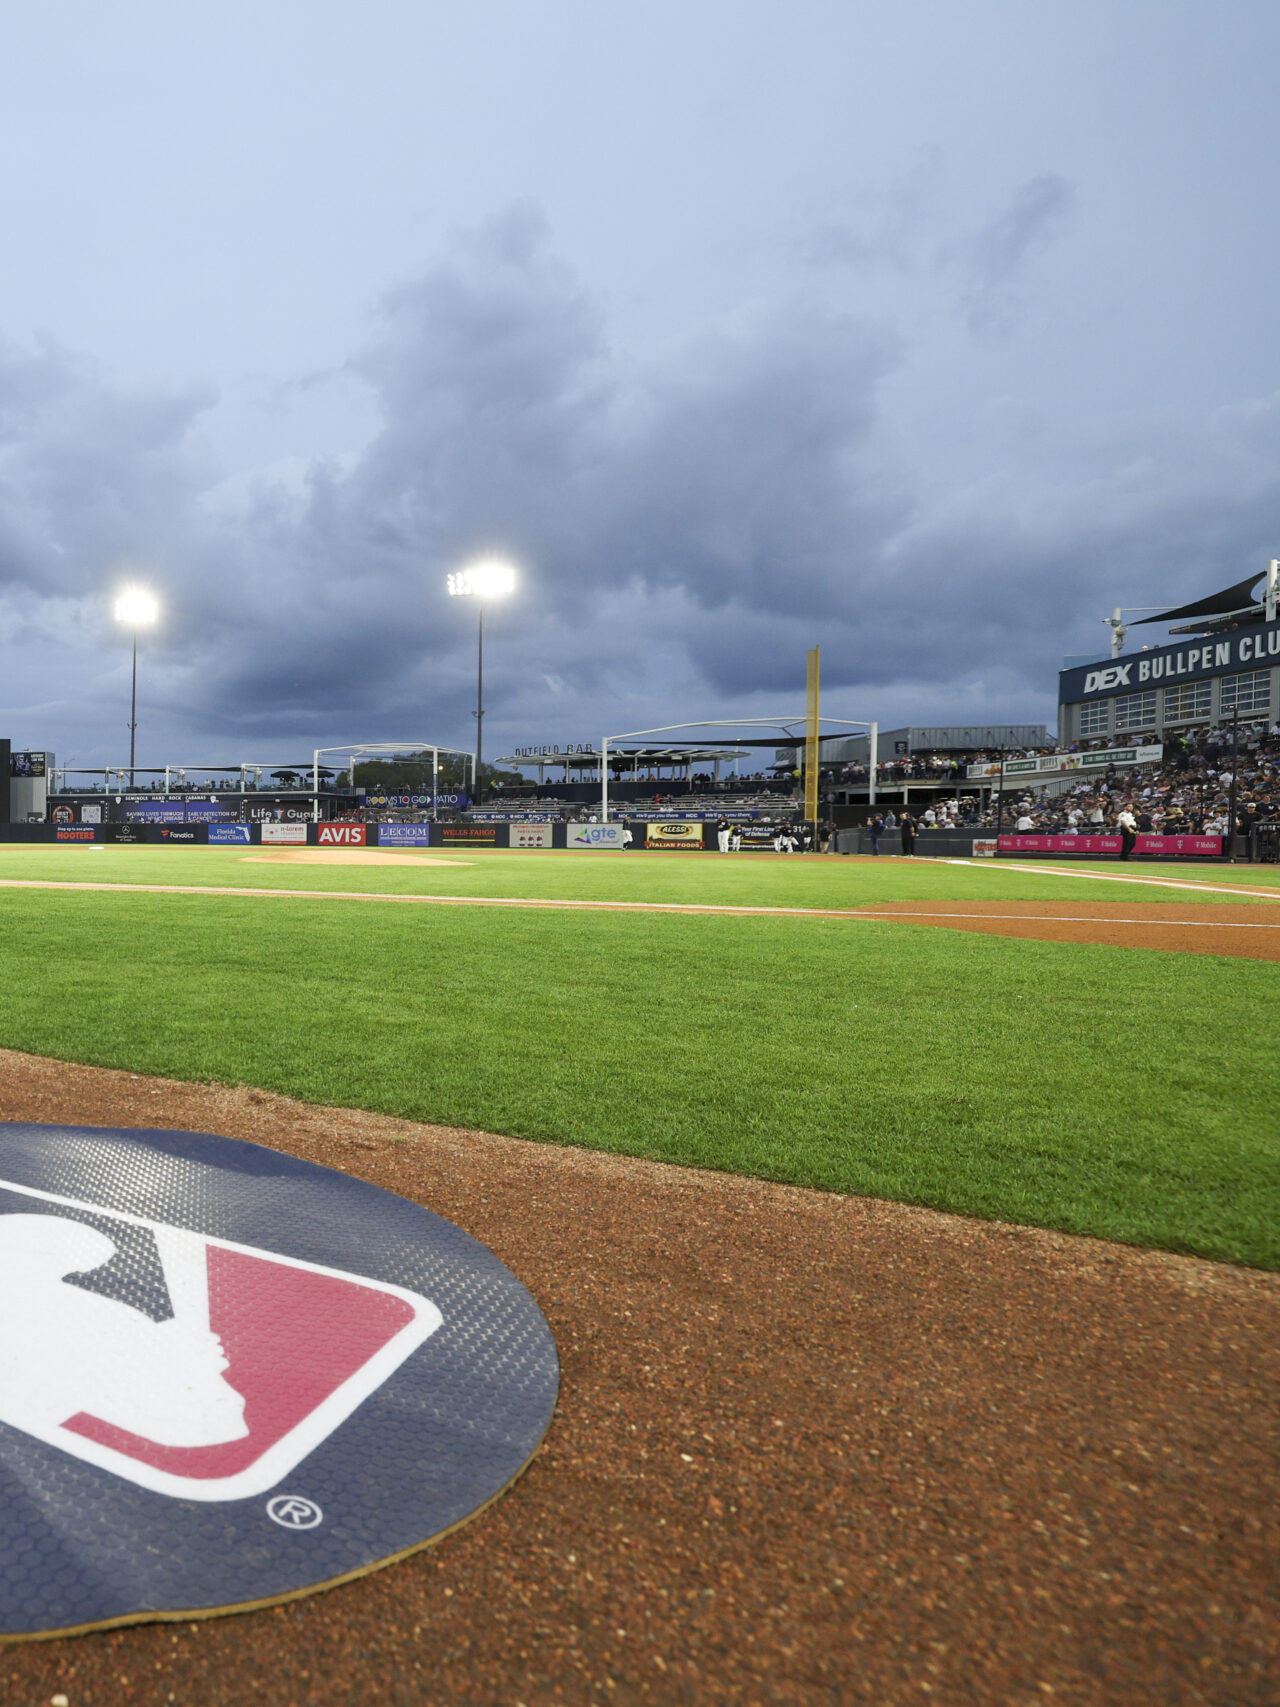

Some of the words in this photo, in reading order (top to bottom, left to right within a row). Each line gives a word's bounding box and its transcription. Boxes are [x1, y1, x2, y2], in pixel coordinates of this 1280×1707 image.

[1084, 662, 1133, 694] DEX
[1138, 641, 1231, 682] BULLPEN
[566, 743, 593, 755] BAR
[365, 795, 398, 804] ROOMS
[399, 796, 410, 804] TO
[411, 796, 427, 804] GO
[251, 808, 272, 818] Life
[56, 831, 95, 840] HOOTERS
[169, 831, 194, 839] Fanatics
[319, 827, 362, 843] AVIS
[380, 827, 427, 836] LECOM
[591, 827, 617, 841] gte
